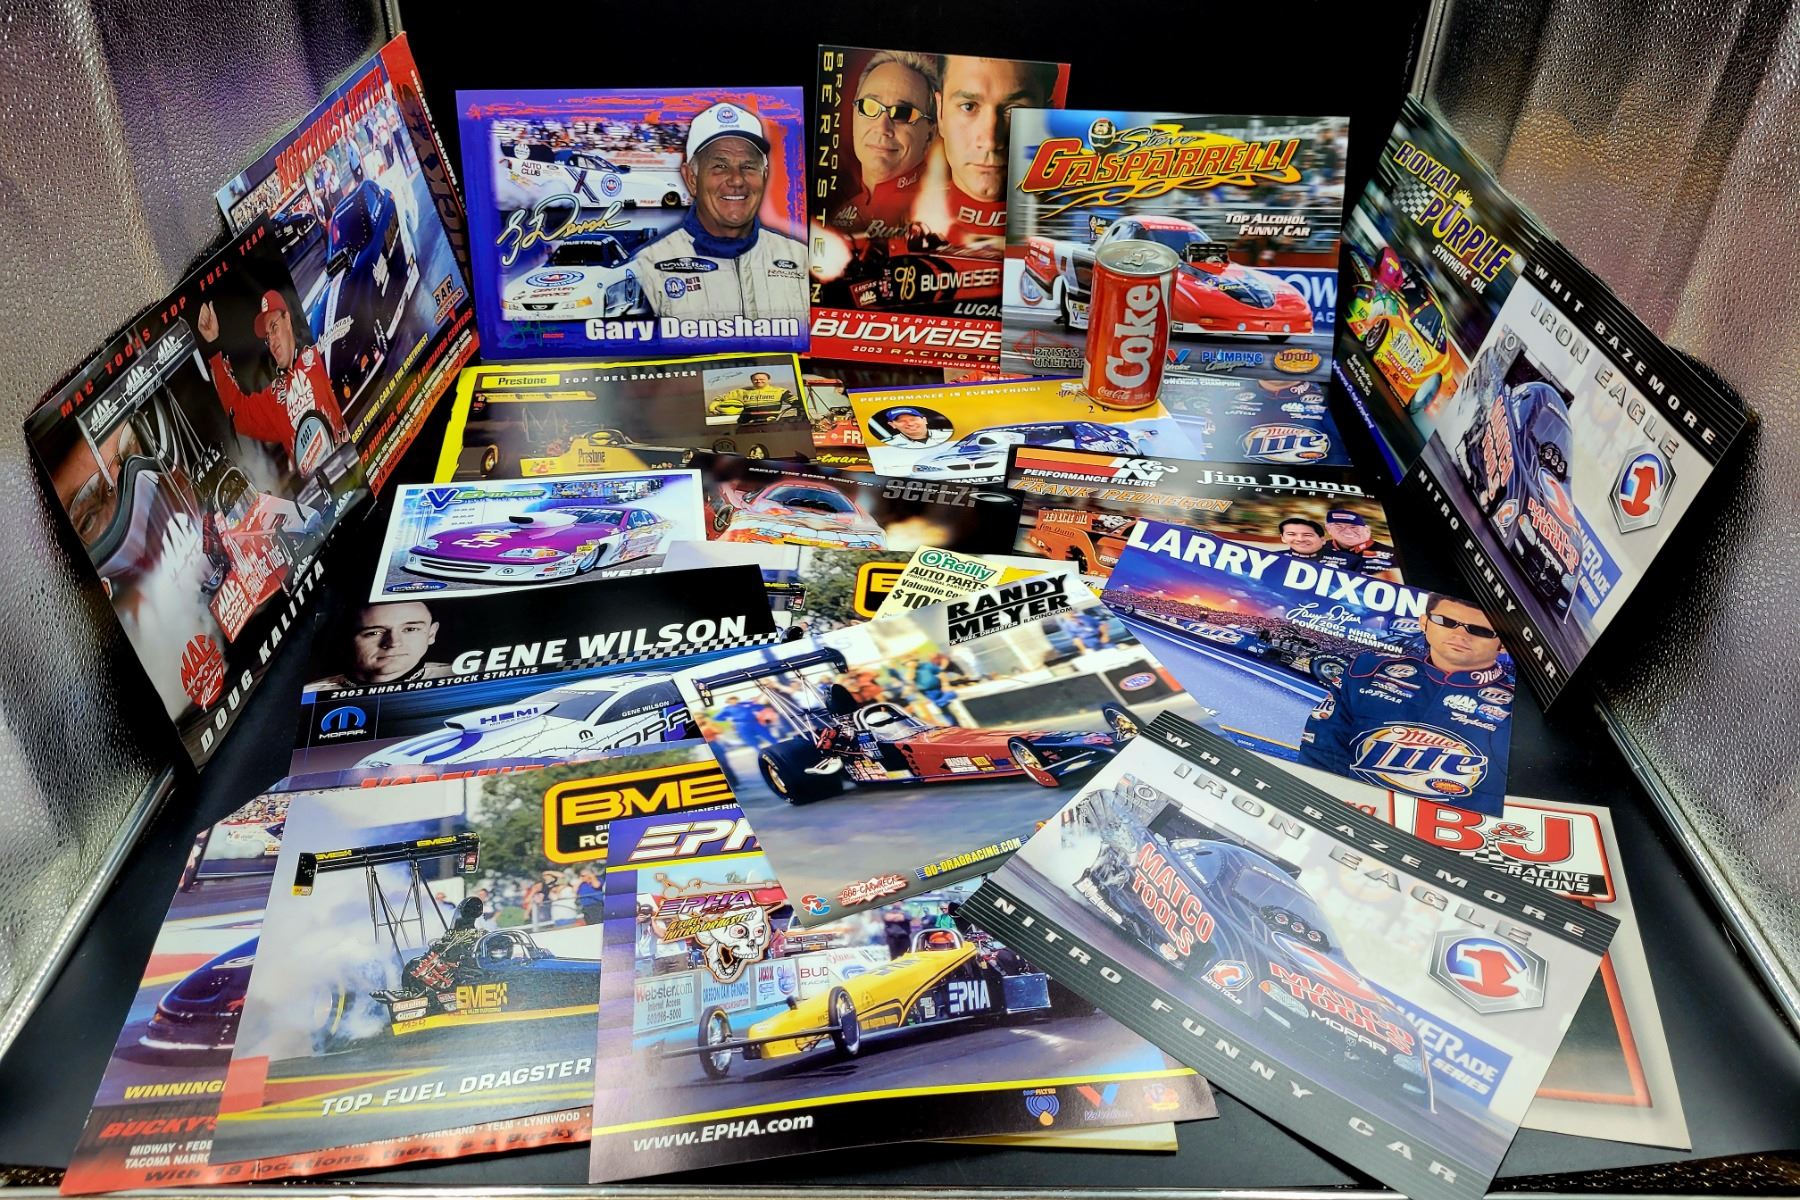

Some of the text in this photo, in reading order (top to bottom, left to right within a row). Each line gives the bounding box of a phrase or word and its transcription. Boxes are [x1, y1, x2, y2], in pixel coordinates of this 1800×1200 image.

[829, 52, 844, 191] BRANDON
[1119, 127, 1200, 158] Steve
[521, 162, 542, 170] AUTO
[521, 169, 541, 177] CLUB
[810, 51, 834, 303] BERNSTEIN
[897, 173, 917, 188] Bud
[1021, 138, 1301, 193] GASPARRELLI
[1393, 142, 1460, 201] ROYAL
[1225, 213, 1306, 226] TOP ALCOHOL
[1239, 224, 1311, 238] FUNNY CAR
[1416, 191, 1515, 284] PURPLE
[1432, 244, 1487, 295] SYNTHETIC OIL
[60, 225, 266, 418] MAC TOOLS TOP FUEL TEAM
[585, 315, 799, 343] Gary Densham
[818, 310, 994, 330] KENNY BERNSTEIN
[1034, 347, 1079, 358] PRISMS
[1104, 285, 1160, 389] Coke
[852, 346, 883, 354] 2003
[891, 348, 969, 361] RACING
[937, 360, 977, 369] BRANDON
[1202, 351, 1264, 363] PLUMBING
[1535, 263, 1715, 445] WHIT BAZEMORE
[368, 307, 473, 456] MUFFLER, BRAKES RADIATOR CENTERS
[498, 376, 547, 386] Prestone
[631, 370, 698, 381] DRAGSTER
[1531, 298, 1680, 460] IRON EAGLE
[363, 400, 381, 426] FUNNY
[379, 387, 391, 404] CAR
[388, 378, 396, 391] IN
[860, 392, 944, 402] PERFORMANCE
[966, 386, 1041, 397] EVERYTHING!
[578, 449, 605, 463] Prestone
[1246, 434, 1329, 456] Lite
[1023, 468, 1157, 487] PERFORMANCE FILTERS
[1108, 457, 1180, 481] K&N
[1197, 468, 1364, 495] Jim Dunn
[1013, 480, 1234, 514] FRANK PEDREGON
[1237, 485, 1335, 499] racing
[1053, 527, 1075, 537] Dunn
[1074, 513, 1087, 523] OIL
[1528, 497, 1579, 568] MATCO
[1531, 511, 1575, 575] TOOLS
[1536, 537, 1563, 576] MOPAR
[909, 566, 989, 590] AUTO PARTS
[918, 550, 997, 581] O'Reilly
[1127, 520, 1428, 617] LARRY DIXON
[1418, 470, 1557, 679] NITRO FUNNY CAR
[901, 579, 945, 595] Valuable
[947, 574, 1068, 620] RANDY
[948, 595, 1073, 642] MEYER
[1023, 606, 1073, 624] RACING.COM
[1320, 620, 1377, 640] 2002 NHRA
[200, 672, 253, 752] DOUG
[258, 560, 324, 665] KALITTA
[452, 615, 746, 676] GENE WILSON
[1347, 634, 1404, 654] CHAMPION
[331, 667, 538, 699] 2003 NHRA PRO STOCK STRATUS
[480, 706, 538, 724] HEMI
[622, 701, 669, 717] GENE WILSON
[1392, 726, 1464, 748] Miller
[1350, 740, 1488, 776] Lite
[562, 774, 736, 825] BME
[1164, 732, 1585, 937] WHIT BAZEMORE
[1414, 799, 1575, 864] B&J
[1173, 762, 1533, 945] IRON EAGLE
[1505, 865, 1589, 883] RACING
[658, 891, 753, 916] EPHA
[1137, 841, 1215, 944] MATCO
[665, 911, 756, 942] NITRO DRAGSTER
[1131, 867, 1193, 956] TOOLS
[949, 980, 991, 1013] EPHA
[1269, 962, 1416, 1047] MATCO
[1284, 981, 1413, 1056] TOOLS
[1311, 1010, 1388, 1056] MOPAR
[994, 897, 1459, 1185] NITRO FUNNY CAR
[321, 1057, 592, 1117] TOP FUEL DRAGSTER
[1433, 1060, 1490, 1095] SERIES
[486, 1119, 513, 1132] YELM
[524, 1112, 580, 1126] LYNNWOOD
[632, 1115, 814, 1153] www.EPHA.com
[125, 1158, 170, 1169] TACOMA
[130, 1143, 176, 1156] MIDWAY
[250, 1147, 369, 1178] locations,
